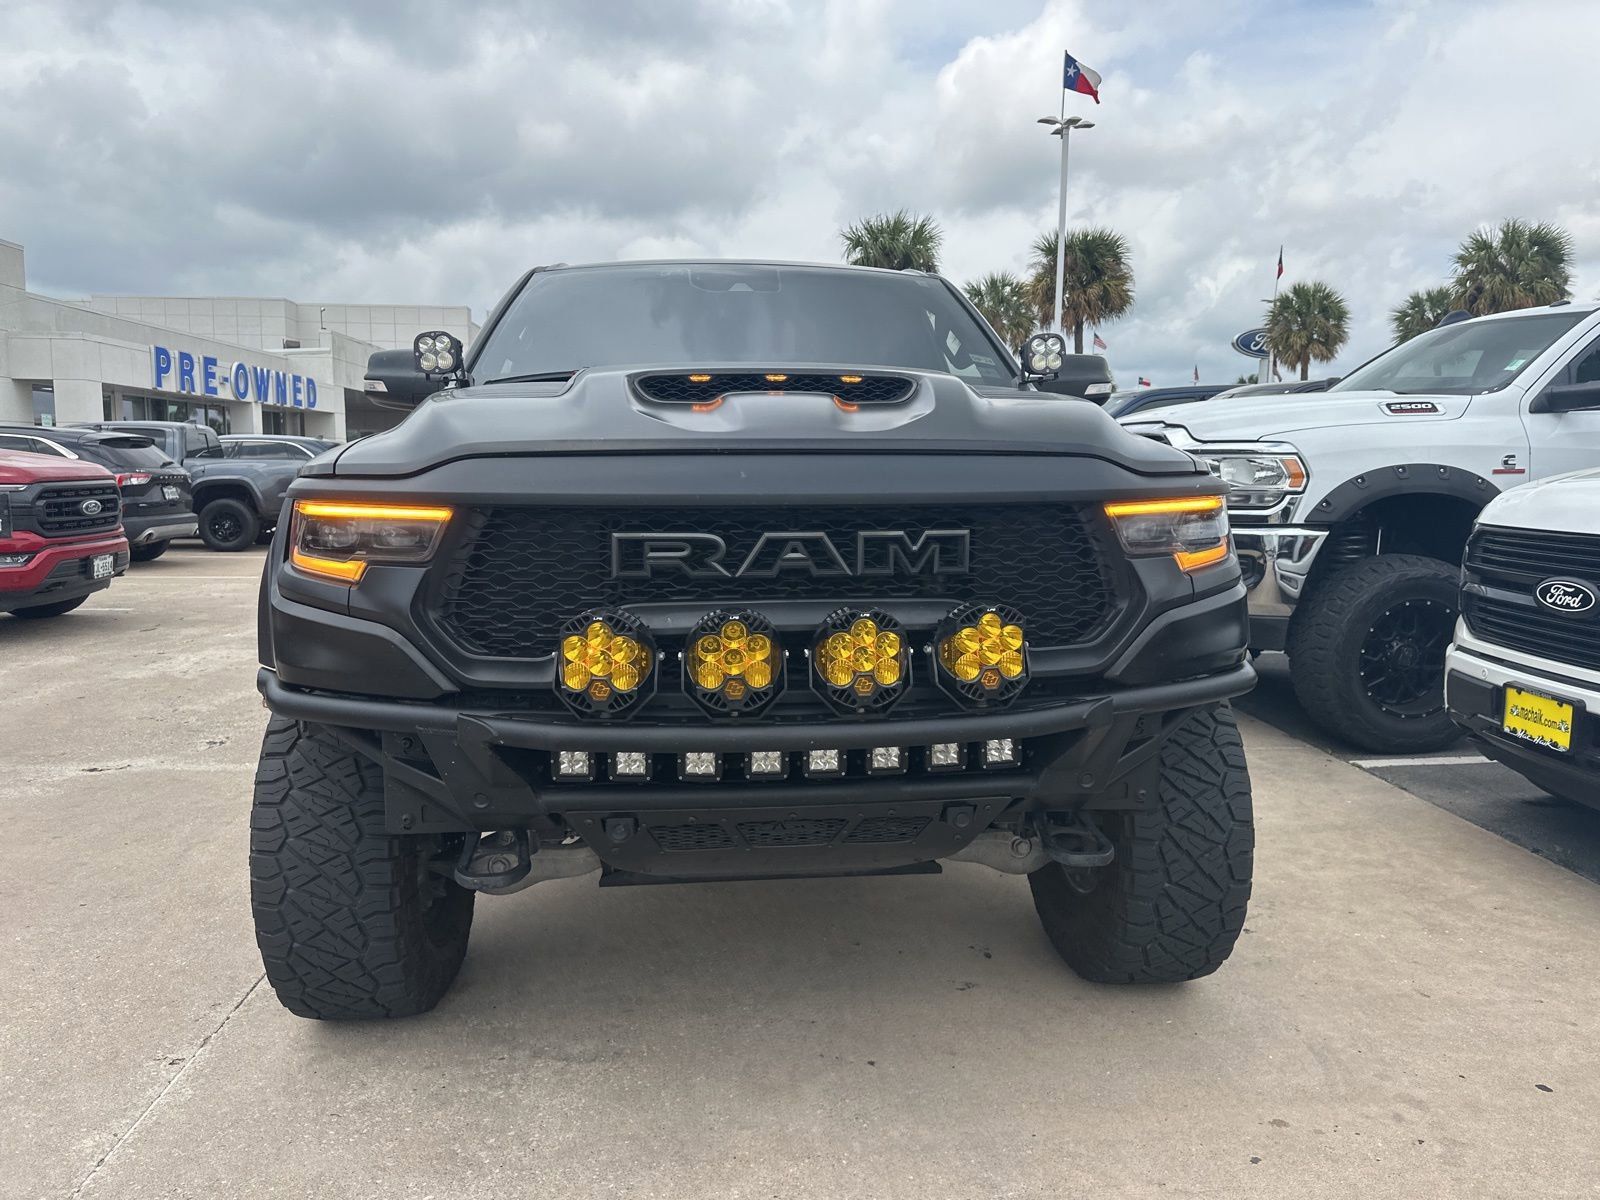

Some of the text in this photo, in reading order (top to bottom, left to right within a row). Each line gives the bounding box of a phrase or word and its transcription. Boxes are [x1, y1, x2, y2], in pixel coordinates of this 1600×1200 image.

[152, 345, 318, 410] PRE-OWNED
[611, 529, 971, 578] RAM
[1546, 584, 1584, 608] Ford
